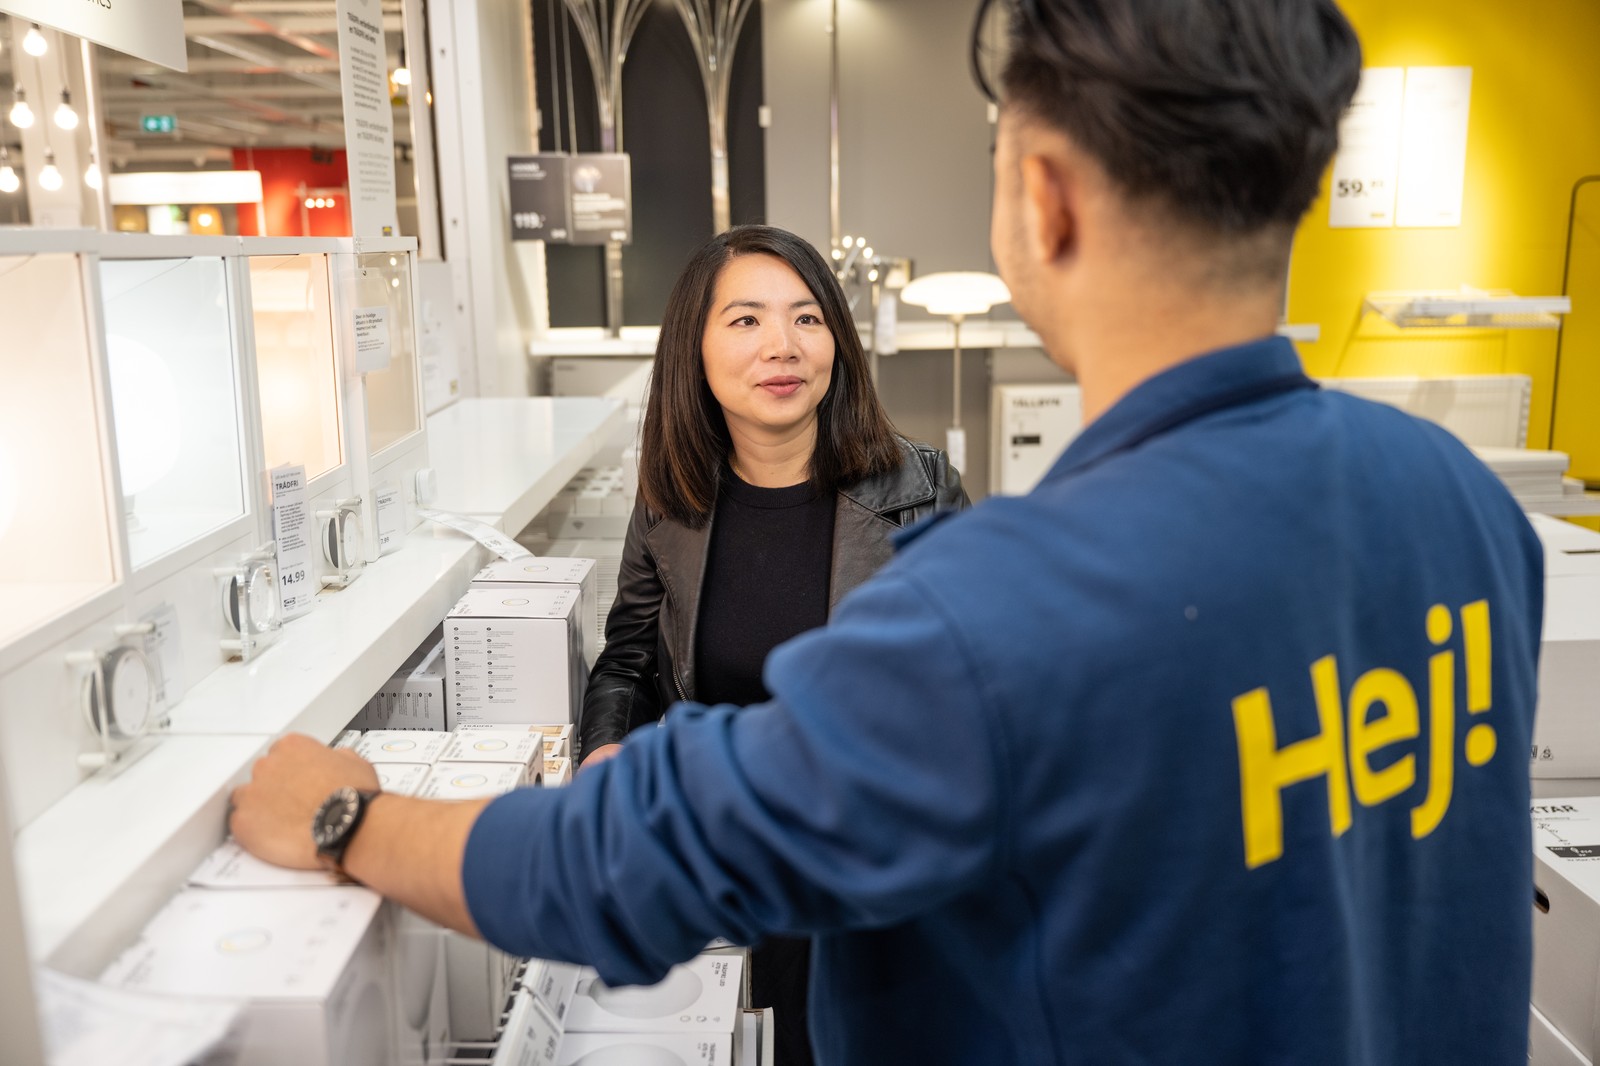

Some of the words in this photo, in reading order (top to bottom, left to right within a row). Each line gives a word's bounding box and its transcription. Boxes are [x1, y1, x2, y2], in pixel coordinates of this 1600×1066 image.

[275, 479, 299, 491] TRÅDFRI
[281, 570, 305, 586] 14.99
[1231, 599, 1497, 870] Hej!
